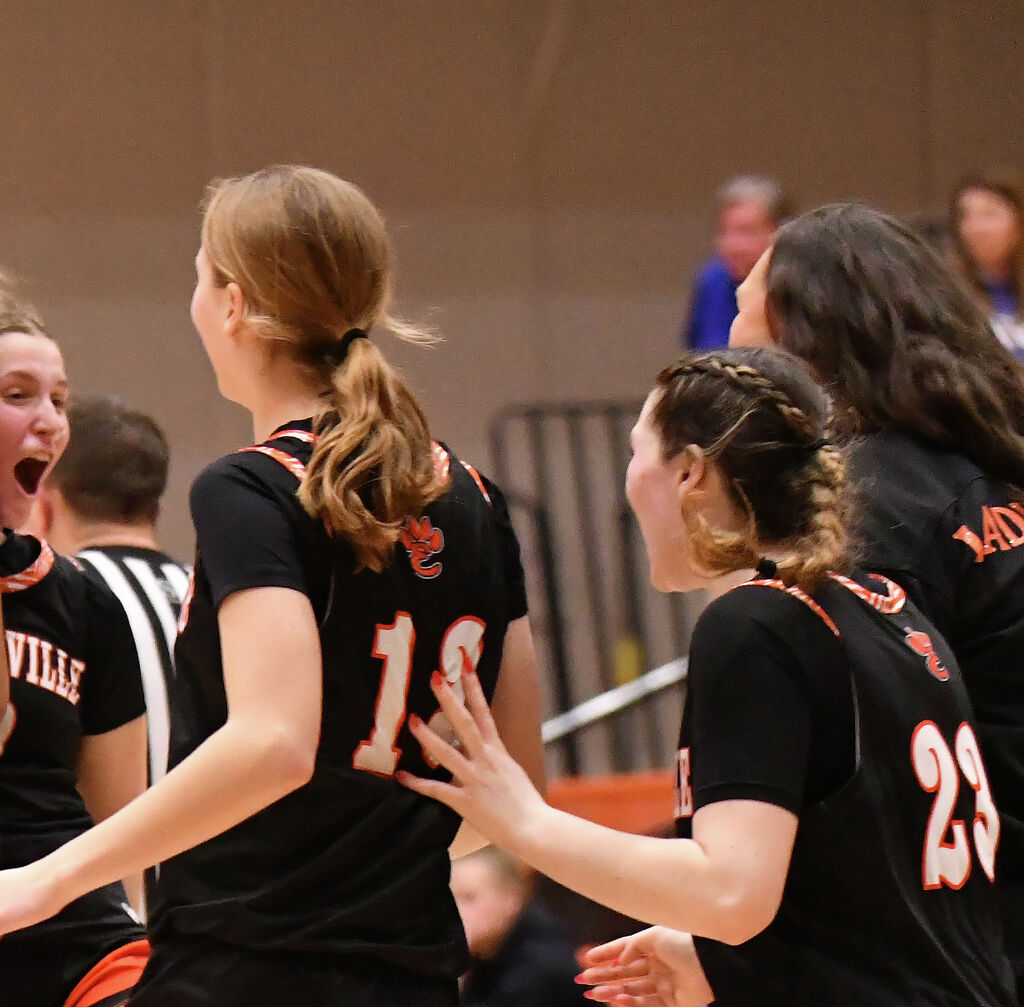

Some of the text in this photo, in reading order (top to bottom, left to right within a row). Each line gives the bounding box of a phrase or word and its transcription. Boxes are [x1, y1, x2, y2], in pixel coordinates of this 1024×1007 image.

[952, 502, 1024, 563] LAD
[4, 629, 86, 706] VILLE
[910, 719, 1001, 891] 23
